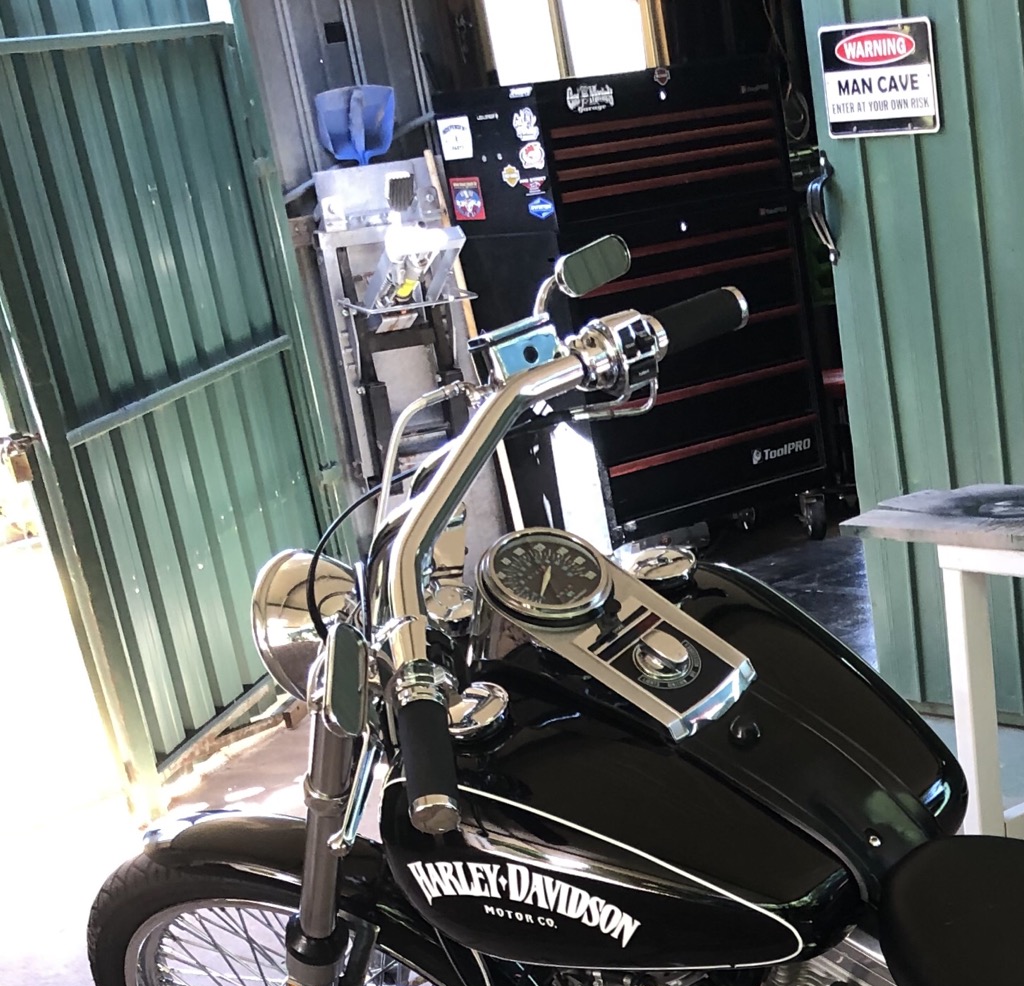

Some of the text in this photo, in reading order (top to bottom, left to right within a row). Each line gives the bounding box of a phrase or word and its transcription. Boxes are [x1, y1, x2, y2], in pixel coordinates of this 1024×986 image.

[843, 37, 907, 60] WARNING
[837, 73, 920, 96] MAN CAVE
[832, 97, 930, 115] ENTER AT YOUR OWN RISK
[763, 437, 811, 461] ToolPRO
[483, 904, 559, 930] MOTOR CO.
